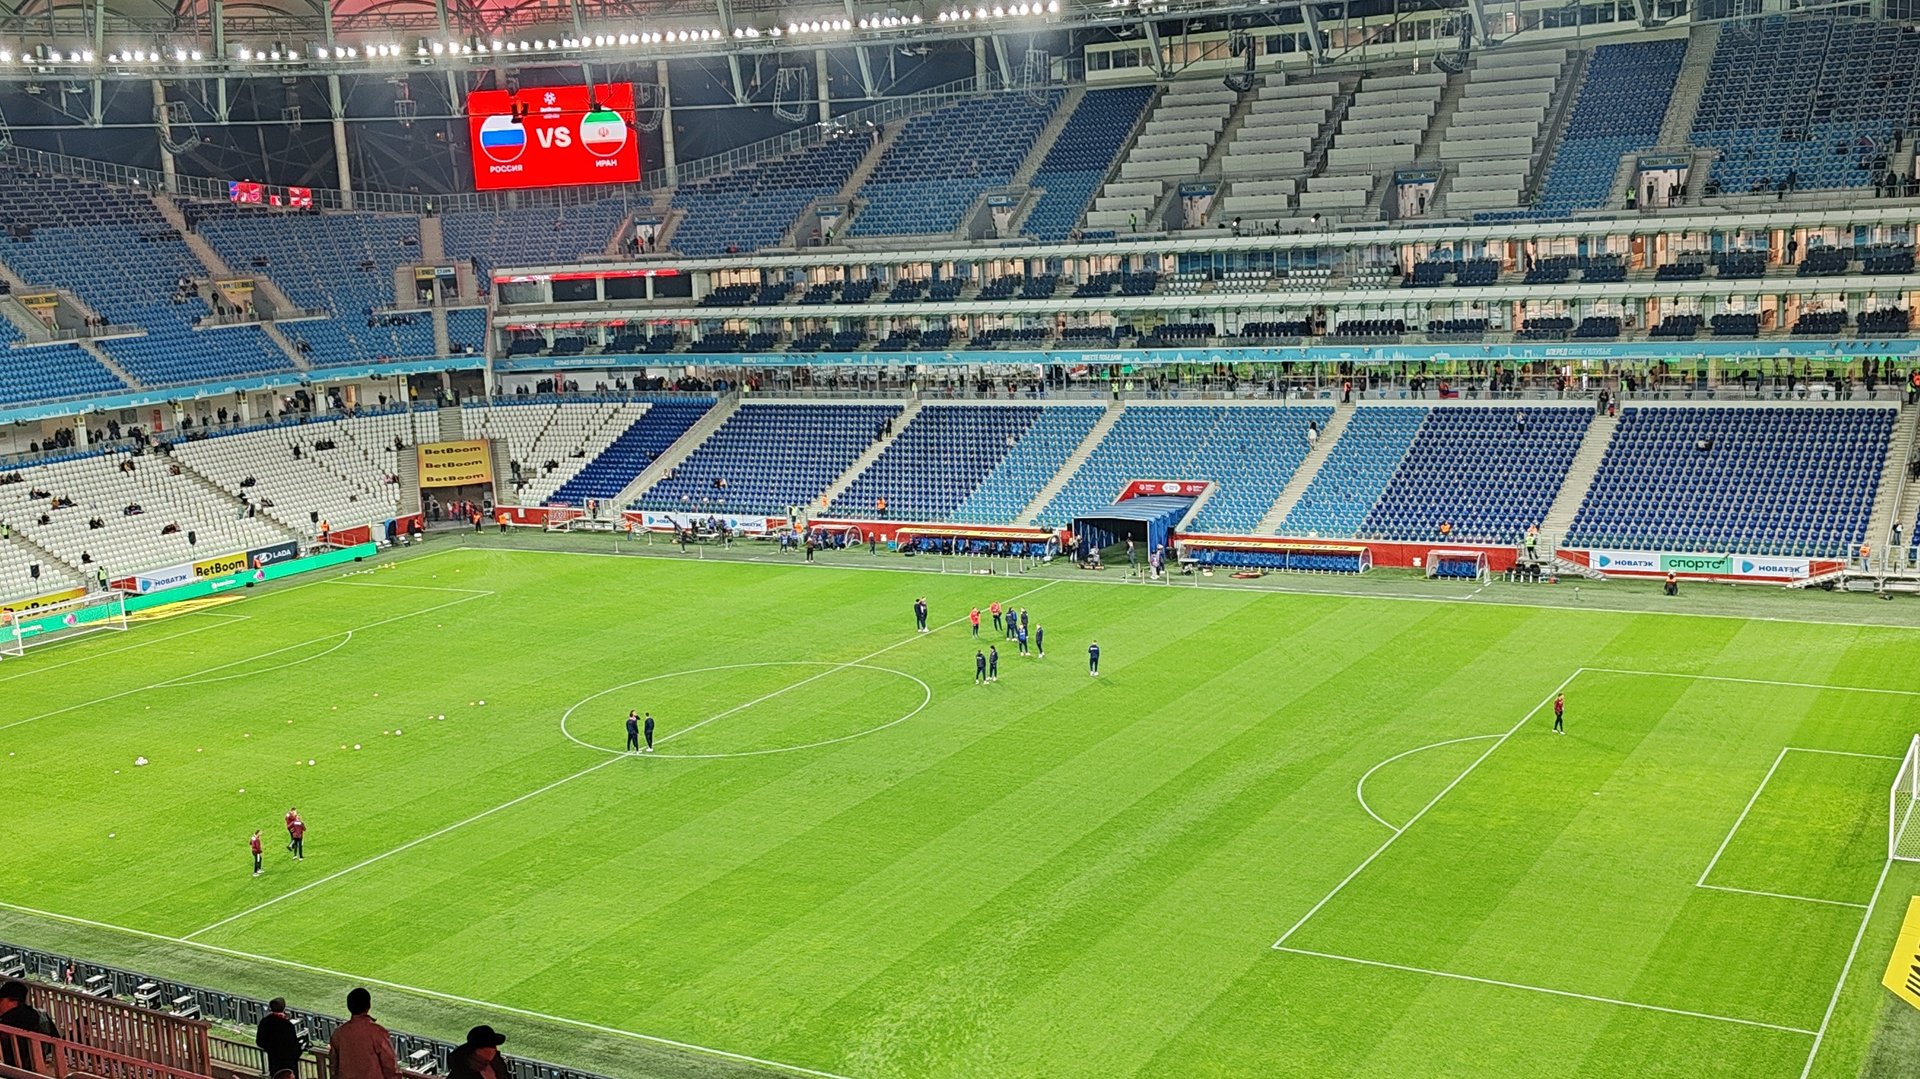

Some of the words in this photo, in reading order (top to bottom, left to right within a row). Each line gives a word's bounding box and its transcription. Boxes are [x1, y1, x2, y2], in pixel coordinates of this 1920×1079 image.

[536, 126, 572, 148] VS
[595, 159, 618, 167] ИРАН
[489, 164, 523, 173] РОССИЯ
[424, 446, 481, 455] BetBoom
[425, 460, 483, 469] BetBoom
[426, 473, 484, 482] BetBoom
[272, 549, 292, 559] LADA
[195, 559, 245, 577] BetBoom
[1758, 565, 1800, 573] НОВАТЭК
[154, 574, 188, 587] НОВАТЭК
